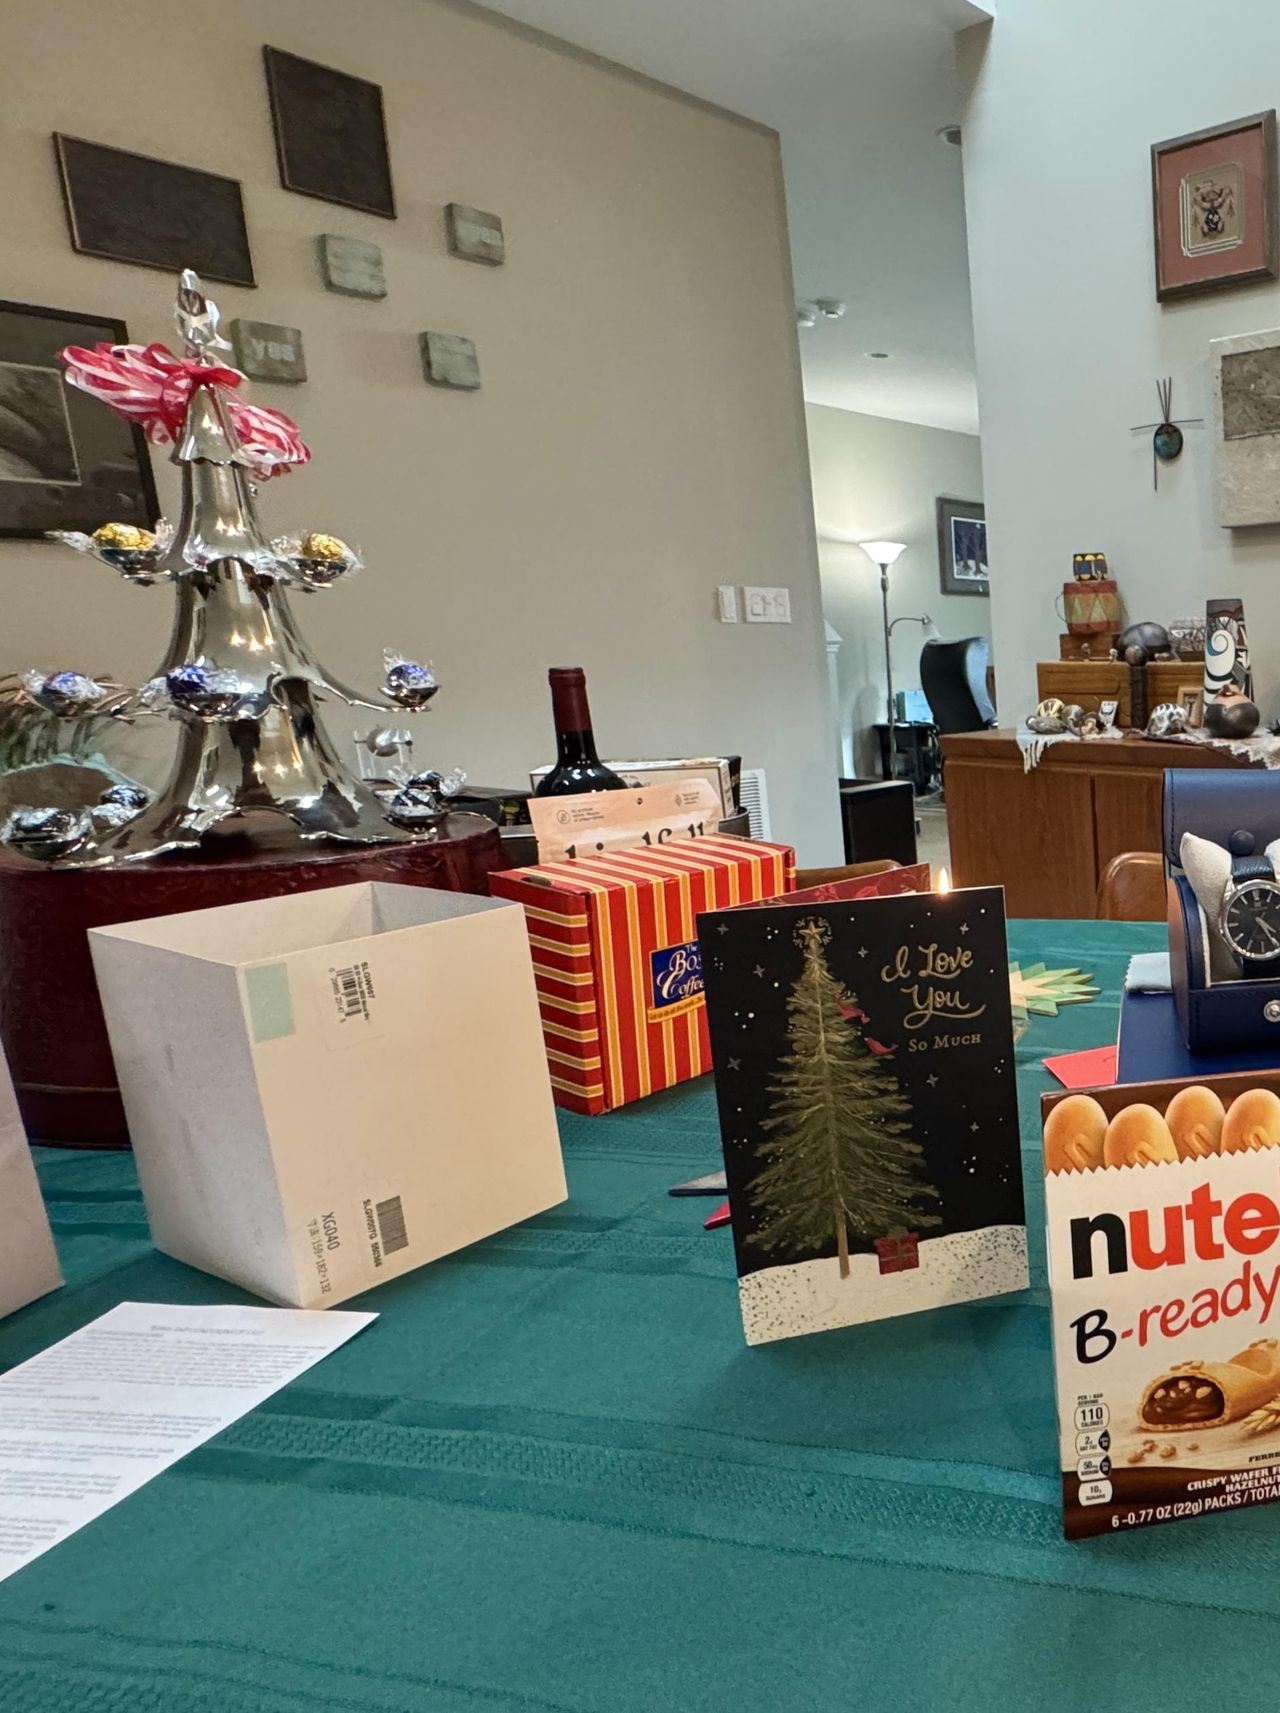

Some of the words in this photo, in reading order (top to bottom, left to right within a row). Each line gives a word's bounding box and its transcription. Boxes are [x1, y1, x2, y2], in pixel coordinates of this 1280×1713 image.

[881, 945, 911, 982] I
[918, 943, 973, 979] Love
[900, 984, 986, 1029] You
[321, 1211, 340, 1250] XG040
[1081, 1407, 1103, 1421] 110
[1187, 1475, 1227, 1491] CRISPY
[1230, 1468, 1269, 1482] WAFER
[1112, 1515, 1119, 1527] 6
[1156, 1505, 1172, 1519] OZ
[1173, 1499, 1203, 1517] (22g)
[1204, 1492, 1241, 1510] PACKS
